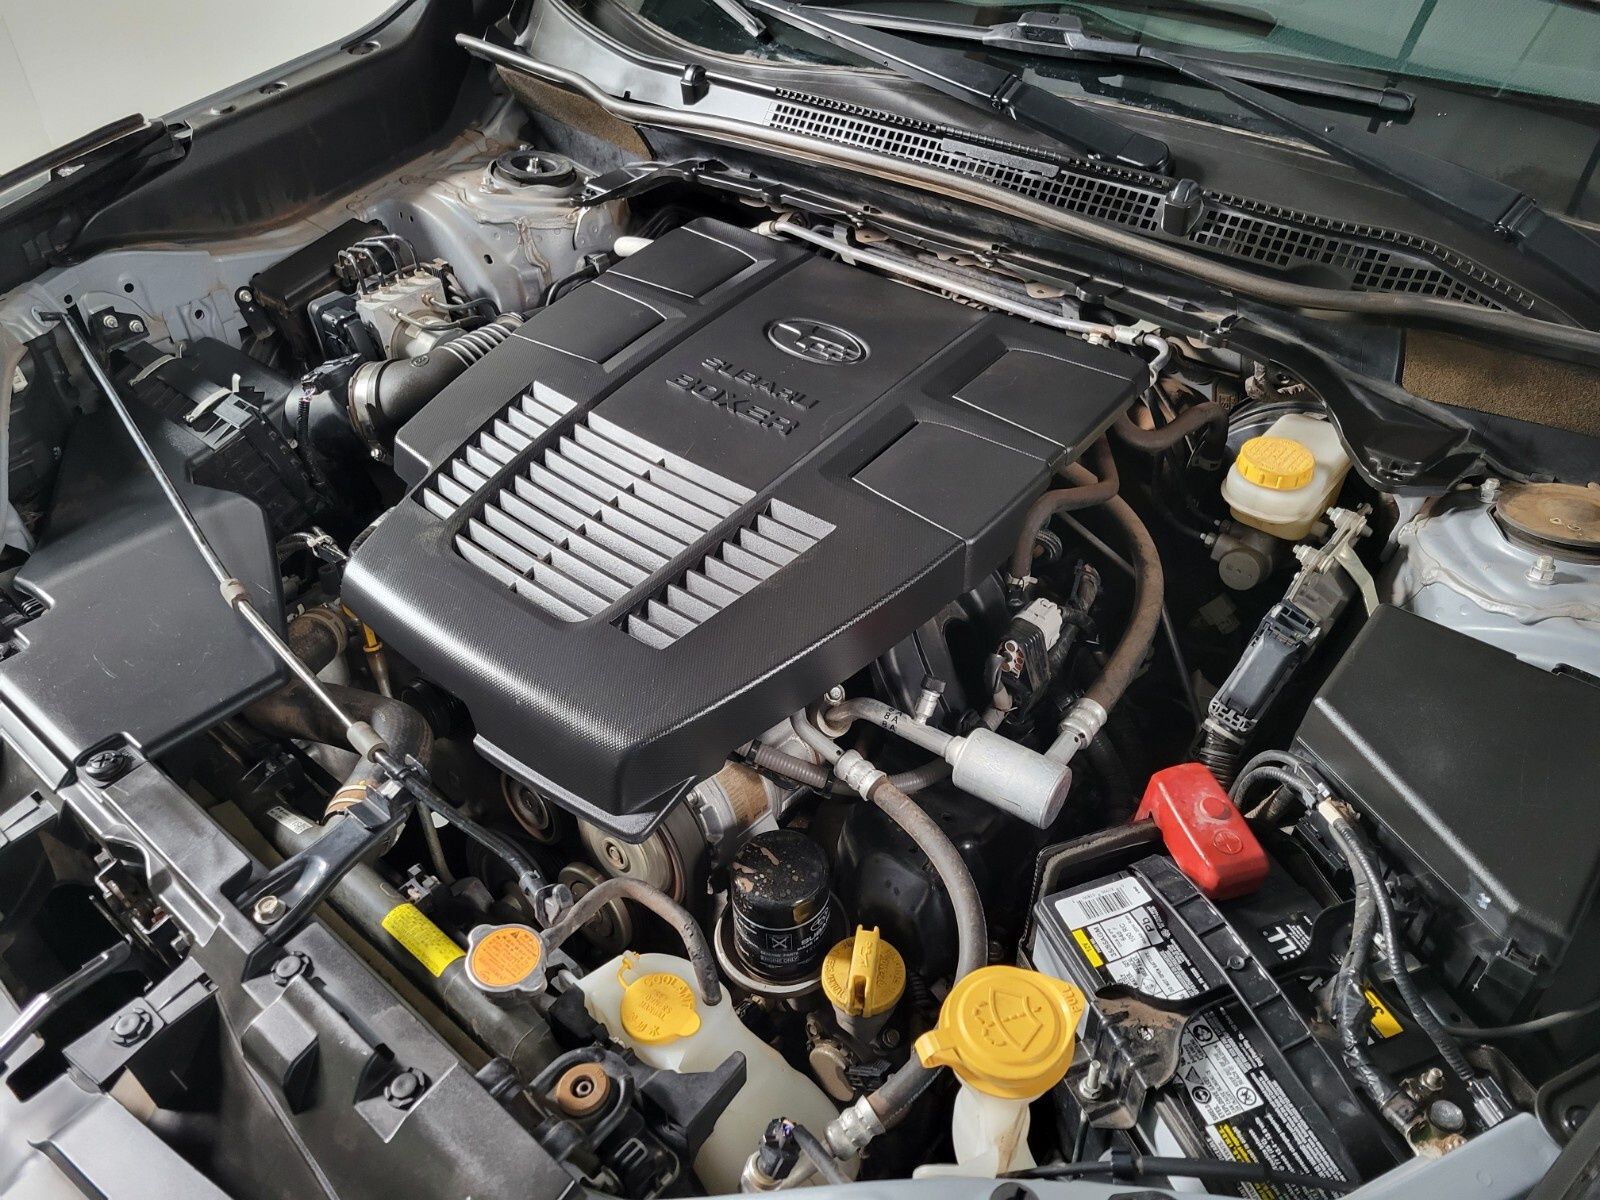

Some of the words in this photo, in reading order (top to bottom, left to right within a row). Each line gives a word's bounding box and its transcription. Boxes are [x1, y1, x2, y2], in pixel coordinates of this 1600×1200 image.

[665, 373, 800, 436] BOXER
[702, 356, 820, 411] SUBARU
[1139, 916, 1156, 933] Pb
[1062, 986, 1083, 1016] FULL
